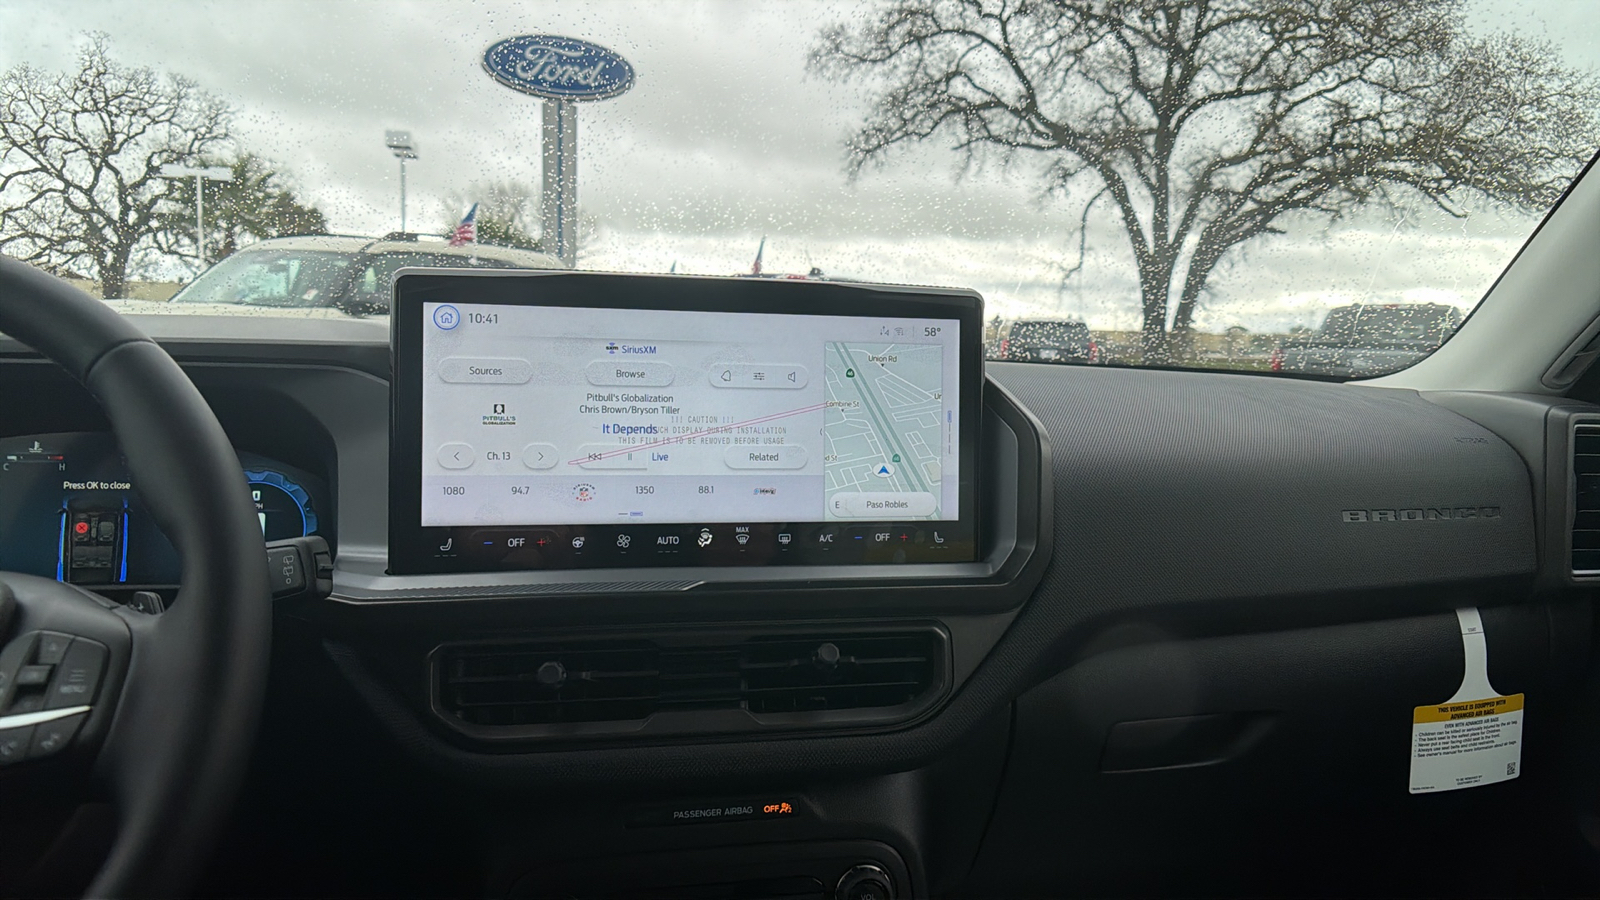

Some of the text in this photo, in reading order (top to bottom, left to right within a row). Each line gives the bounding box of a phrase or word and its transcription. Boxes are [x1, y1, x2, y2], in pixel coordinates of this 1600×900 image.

[515, 45, 606, 85] Ford
[468, 313, 499, 324] 10:41
[621, 345, 657, 354] SiriusXM
[888, 355, 897, 363] Rd
[469, 366, 503, 376] Sources
[615, 369, 645, 379] Browse
[586, 393, 674, 403] Pitbull's Globalization
[579, 405, 680, 416] Chris Brown/Bryson Tiller
[687, 416, 718, 424] CAUTION
[602, 423, 610, 434] It
[612, 423, 658, 436] Depends
[672, 426, 702, 434] DISPLAY
[737, 427, 787, 435] INSTALLATION
[618, 437, 636, 445] THIS
[640, 437, 658, 445] FILM
[662, 437, 671, 445] IS
[687, 437, 696, 445] BE
[700, 437, 730, 445] REMOVED
[734, 437, 760, 445] BEFORE
[763, 437, 785, 445] USAGE
[486, 452, 511, 461] Ch. 13
[652, 453, 669, 461] Live
[749, 453, 779, 462] Related
[3, 463, 9, 471] C
[58, 463, 65, 471] H
[63, 481, 131, 490] Press OK to close
[698, 486, 714, 494] 88.1
[442, 486, 465, 496] 1080
[511, 486, 530, 495] 94.7
[635, 486, 655, 495] 1350
[835, 501, 908, 509] E Paso Robles
[1341, 506, 1501, 523] BRONCO
[657, 536, 679, 545] AUTO
[819, 534, 833, 543] A/C
[875, 533, 891, 542] OFF
[507, 538, 526, 548] OFF
[673, 804, 780, 819] PASSENGER AIRBAG OFF
